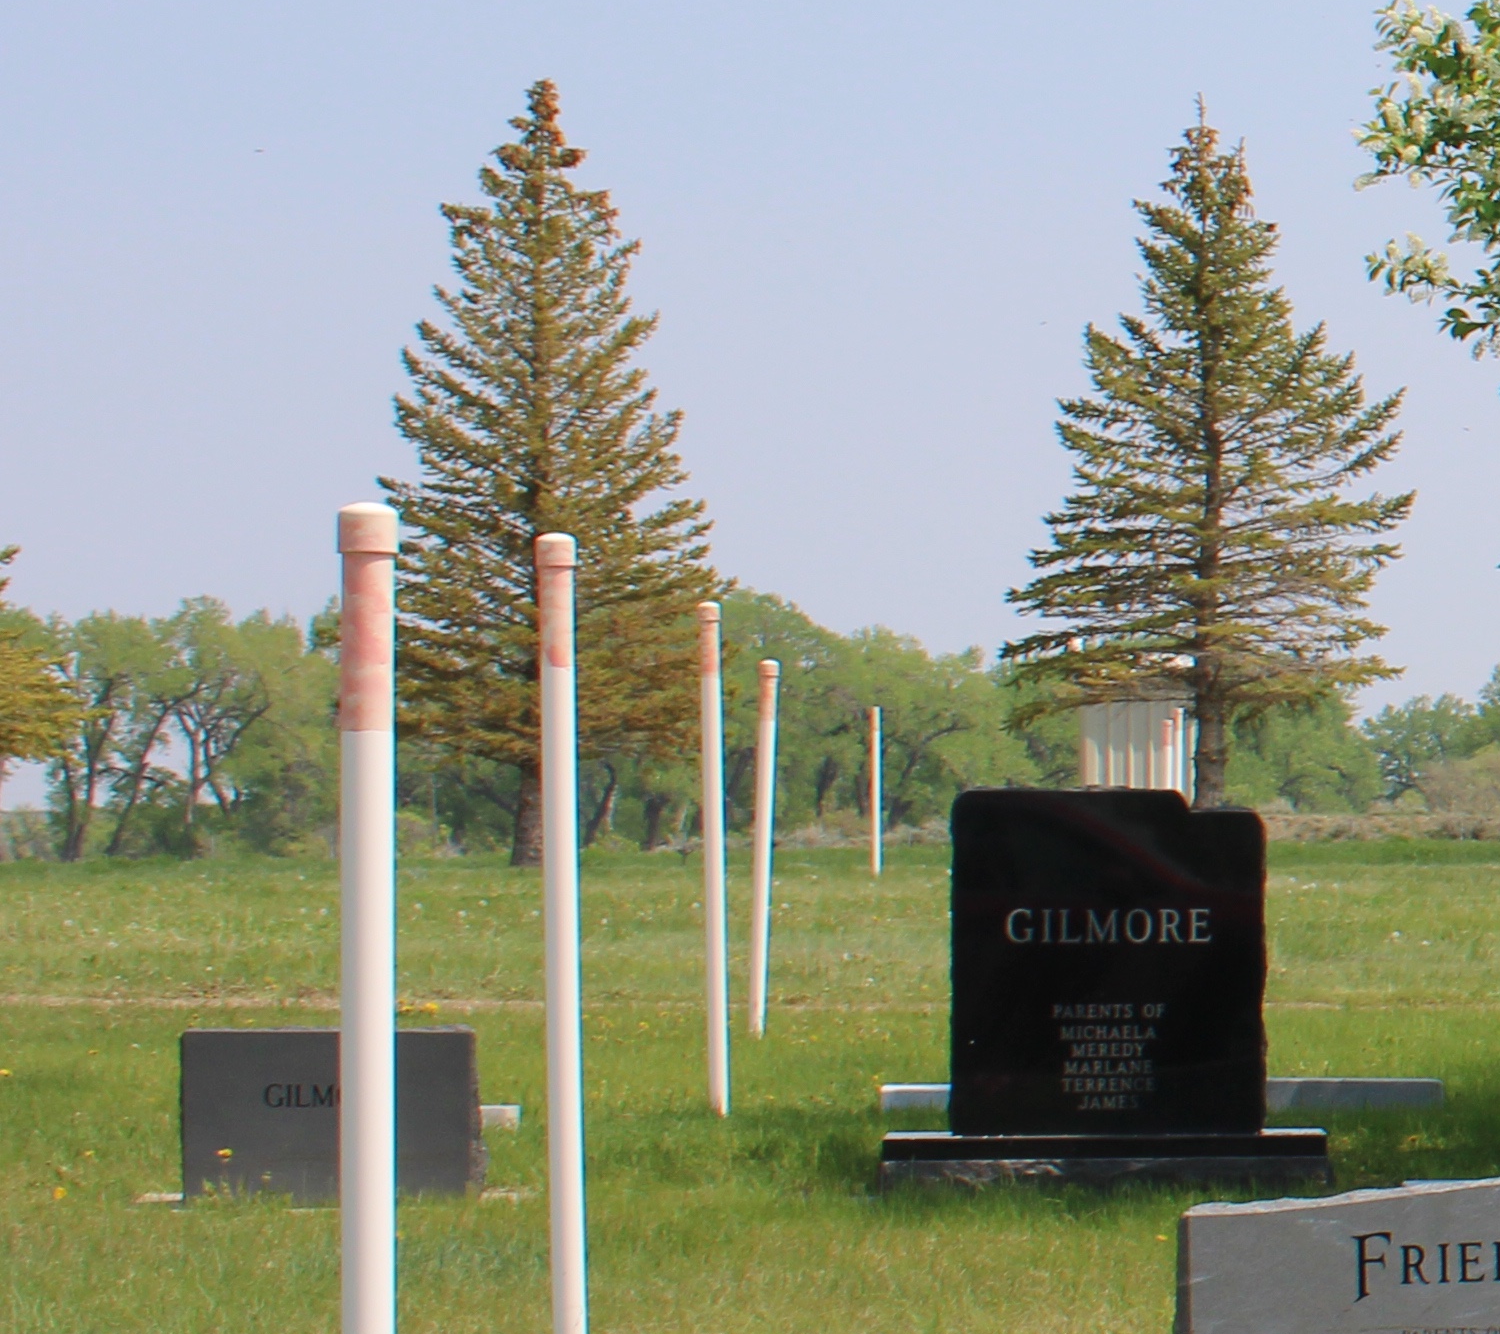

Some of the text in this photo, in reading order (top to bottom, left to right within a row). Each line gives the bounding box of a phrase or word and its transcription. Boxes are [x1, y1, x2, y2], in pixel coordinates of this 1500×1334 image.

[1004, 907, 1213, 945] GILMORE
[1052, 1003, 1167, 1019] PARENTS OF
[1059, 1024, 1158, 1041] MICHAELA
[1069, 1042, 1146, 1058] MEREDY
[1061, 1076, 1156, 1093] TERRENCE
[262, 1082, 341, 1109] GILM
[1076, 1094, 1140, 1111] JAMES
